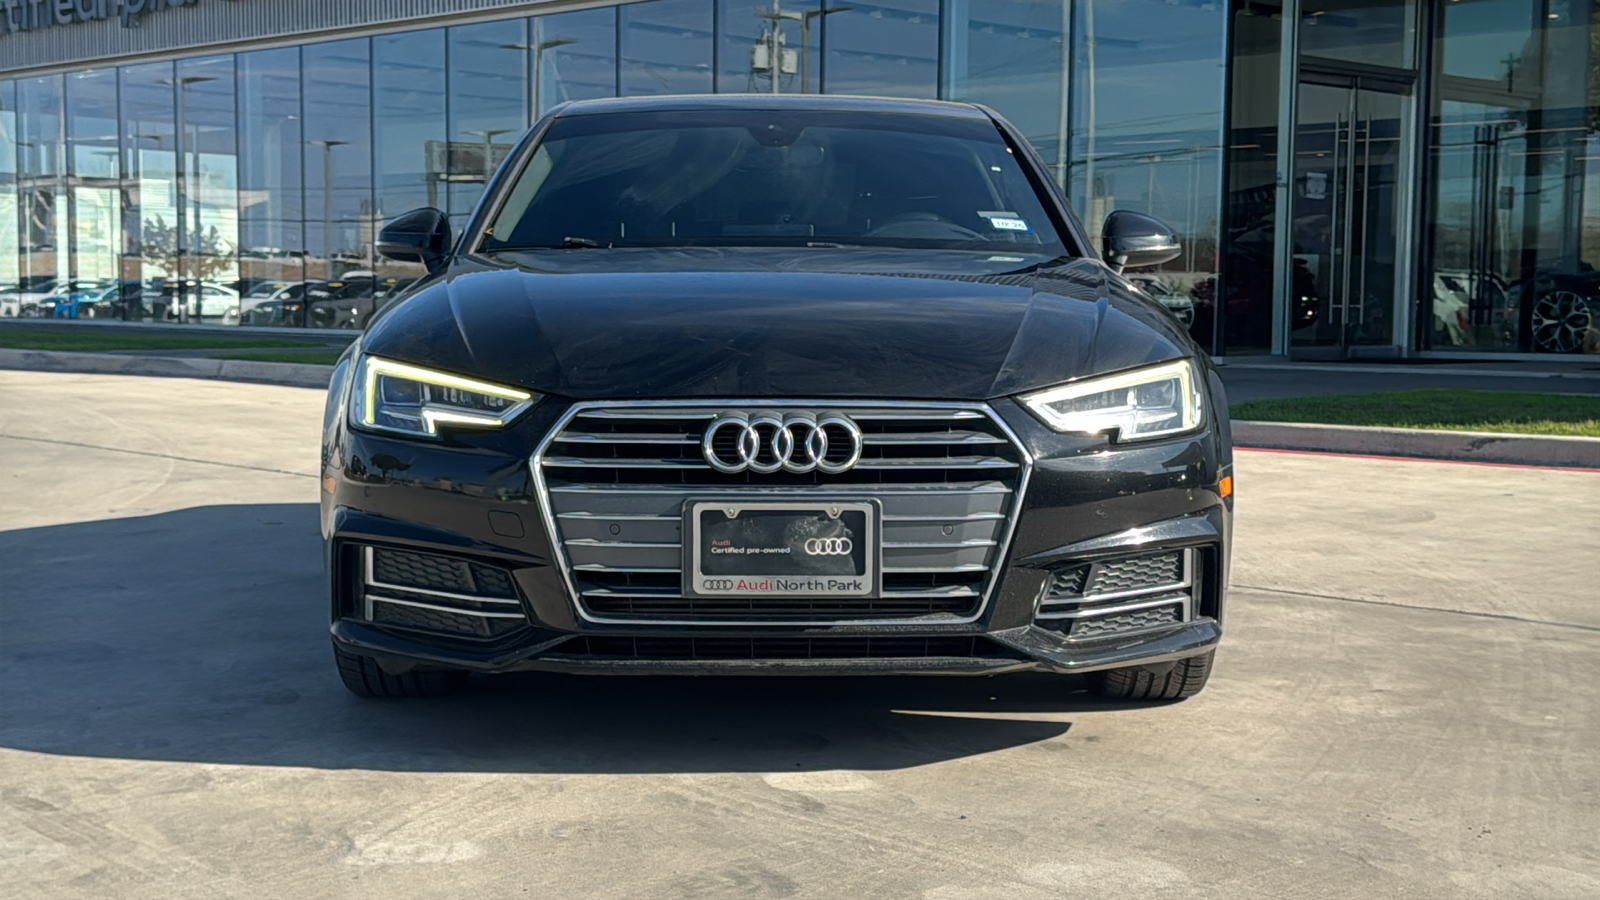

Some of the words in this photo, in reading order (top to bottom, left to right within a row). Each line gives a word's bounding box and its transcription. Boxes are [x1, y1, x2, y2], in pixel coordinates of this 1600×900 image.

[0, 0, 107, 33] tifie
[746, 547, 791, 555] pre-owned
[736, 579, 773, 591] Audi
[776, 579, 824, 591] North
[827, 579, 863, 591] Park
